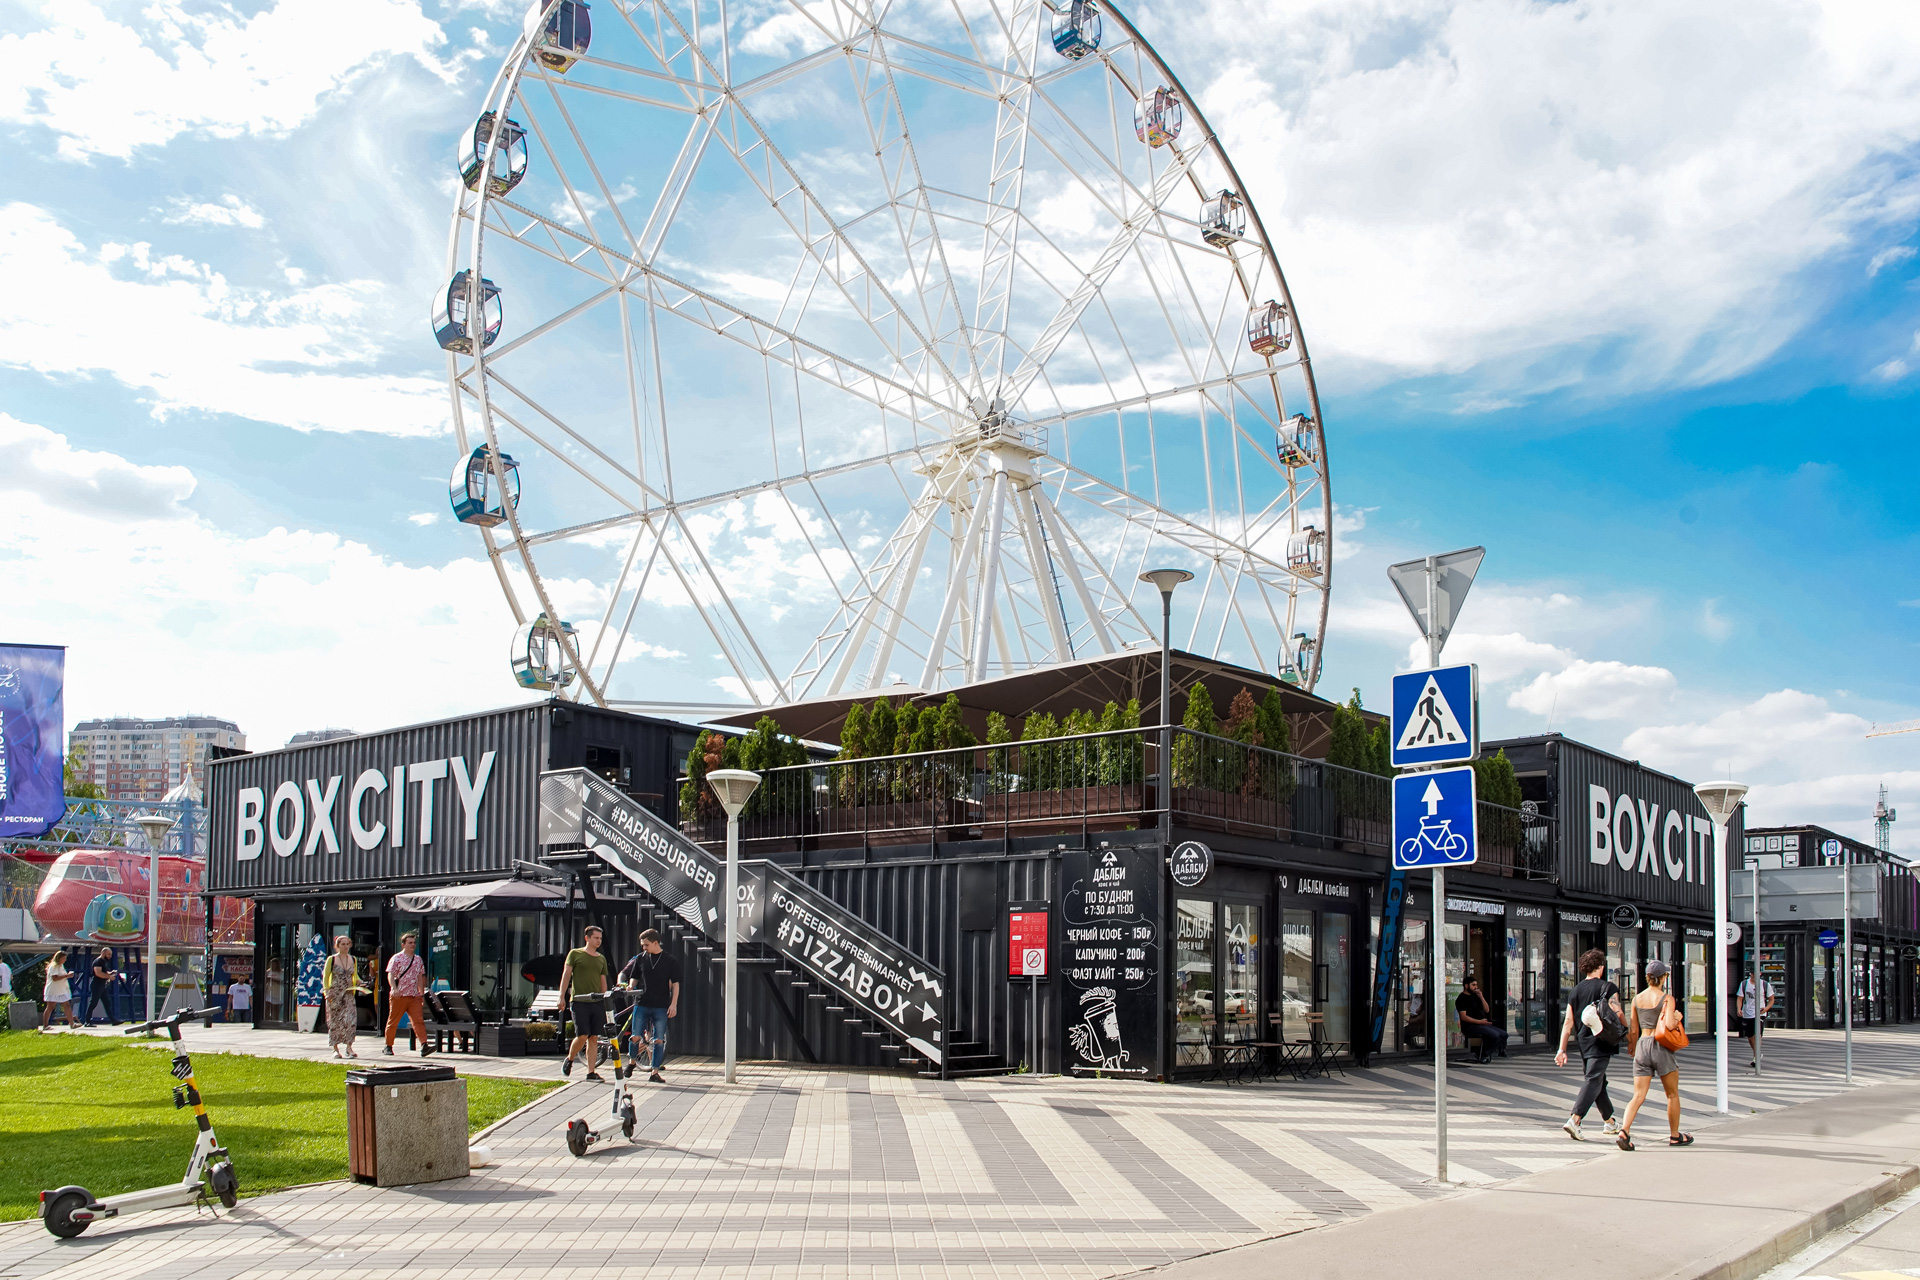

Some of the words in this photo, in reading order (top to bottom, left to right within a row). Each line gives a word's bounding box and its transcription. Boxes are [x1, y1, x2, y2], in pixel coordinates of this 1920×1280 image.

[237, 775, 343, 861] BOX
[349, 750, 497, 851] CITY
[585, 815, 644, 864] #CHINANOODLES
[1589, 783, 1660, 877] BOX
[1662, 808, 1729, 886] CIT
[610, 804, 717, 892] #PAPASBURGER
[1092, 867, 1126, 883] ДАБЛБИ
[1174, 863, 1204, 875] ДАБЛБИ
[736, 884, 756, 901] OX
[1298, 878, 1323, 895] ДАБЛБИ
[1324, 882, 1349, 897] КОФЕЙНЯ
[390, 897, 395, 907] 3
[1085, 891, 1096, 904] ПО
[1098, 890, 1133, 904] БУДНЯМ
[322, 901, 327, 911] 2
[338, 900, 349, 911] SURF
[349, 899, 363, 910] COFFEE
[1090, 905, 1104, 915] 7:30
[1117, 904, 1134, 914] 11:00
[1067, 927, 1098, 941] ЧЕРНЫЙ
[1099, 928, 1122, 941] КОФЕ
[771, 891, 841, 943] #COFFEEBOX
[839, 938, 914, 992] #FRESHMARKET
[1177, 941, 1190, 950] КОФЕ
[1195, 940, 1204, 951] ЧАЙ
[1075, 948, 1117, 961] КАПУЧИНО
[777, 918, 911, 1024] #PIZZABOX
[1072, 967, 1092, 980] ФЛЭТ
[1094, 966, 1115, 980] УАЙТ
